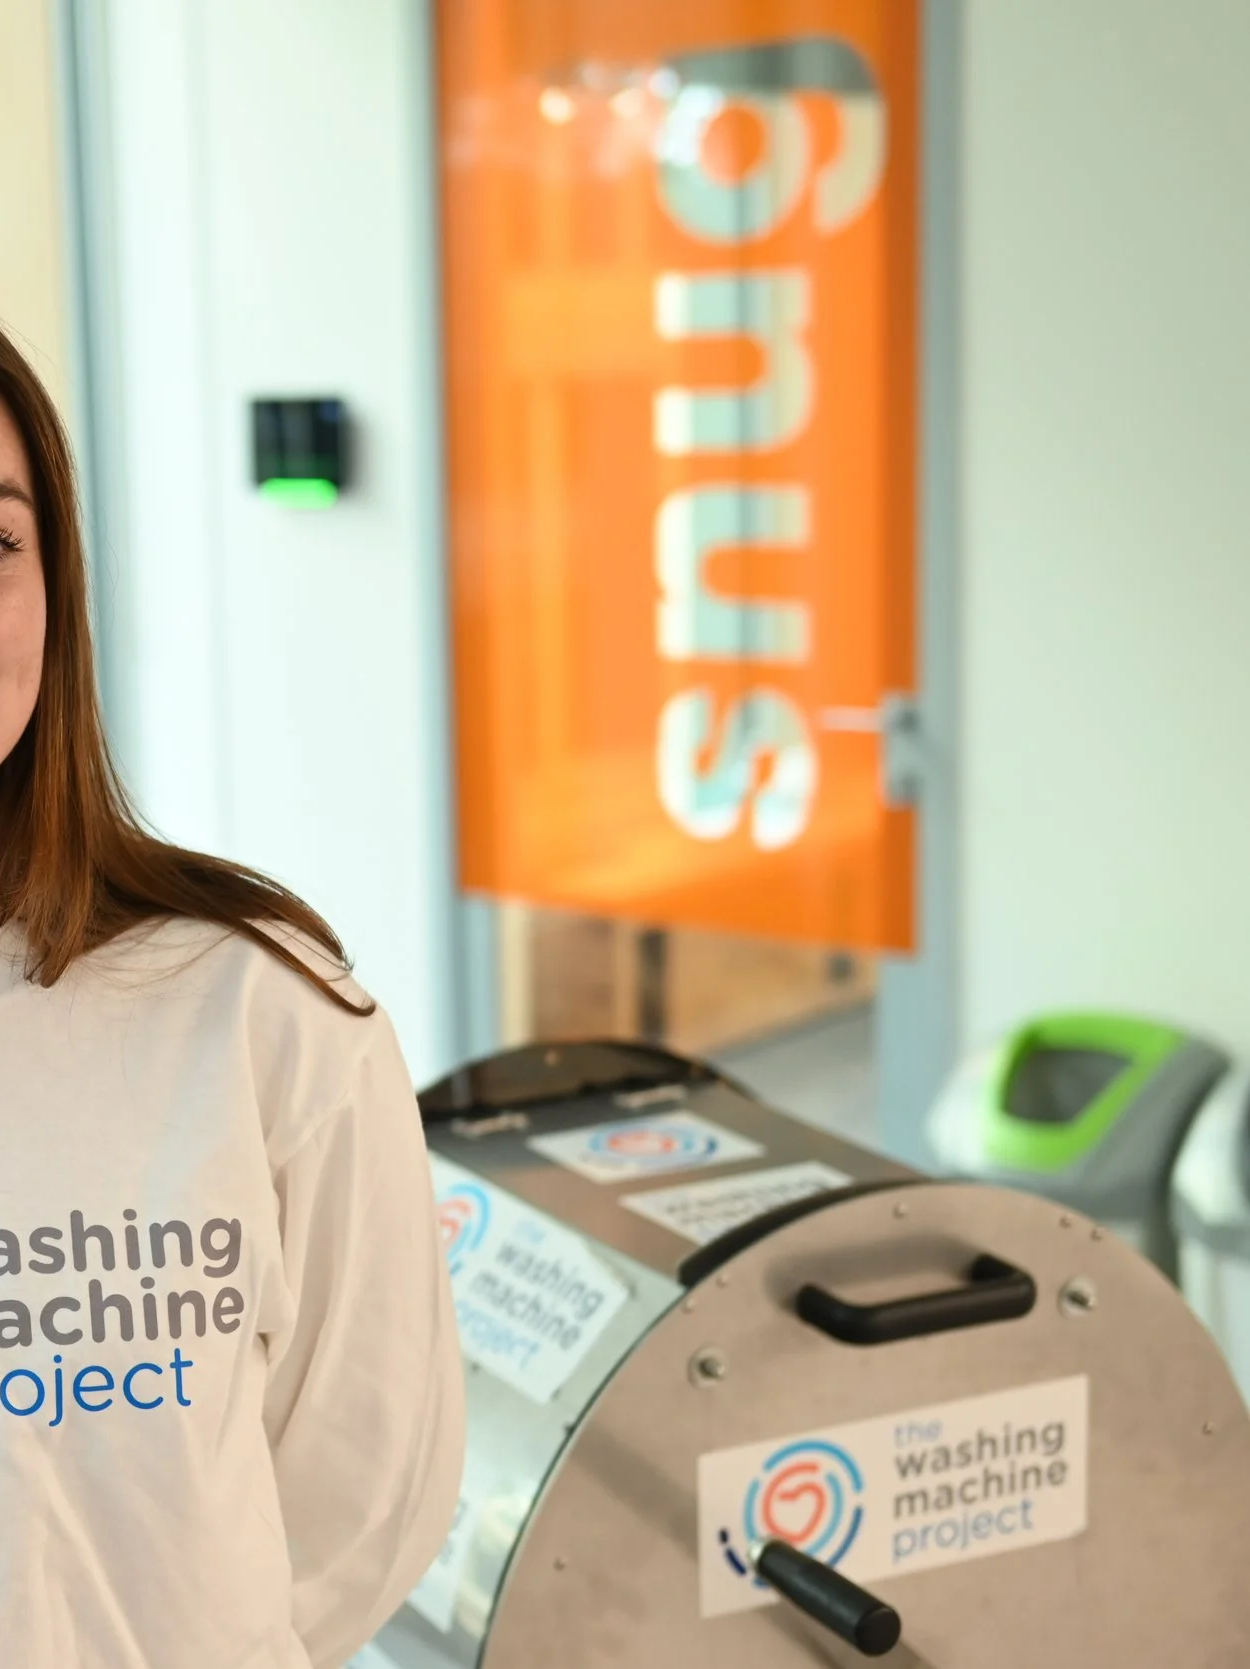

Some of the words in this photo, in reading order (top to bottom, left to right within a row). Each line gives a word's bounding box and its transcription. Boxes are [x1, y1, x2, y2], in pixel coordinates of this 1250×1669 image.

[654, 34, 888, 851] snug
[894, 1421, 1065, 1480] washing
[895, 1420, 943, 1448] the
[893, 1459, 1068, 1519] machine
[892, 1499, 1034, 1565] project
